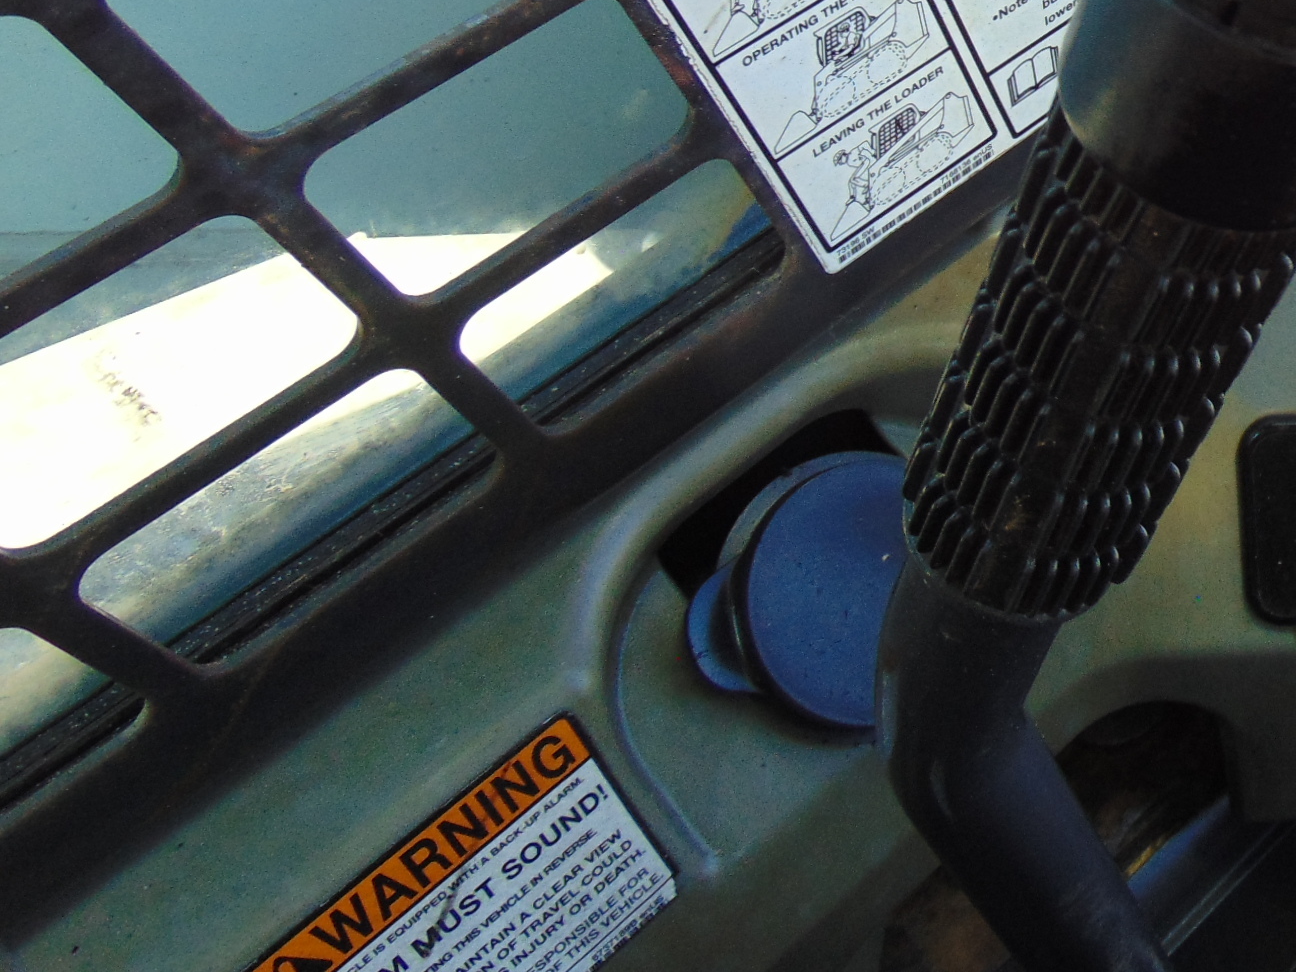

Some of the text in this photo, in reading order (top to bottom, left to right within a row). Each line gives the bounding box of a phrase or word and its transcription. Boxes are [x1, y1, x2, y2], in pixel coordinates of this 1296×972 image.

[742, 14, 819, 67] OPERATING
[812, 66, 944, 157] LEAVING THE LOADER
[308, 735, 575, 955] WARNING
[372, 943, 386, 956] IS
[386, 891, 447, 944] EQUIPPED
[448, 864, 479, 891] WITH
[479, 856, 490, 867] A
[490, 811, 541, 857] BACK-UP
[543, 777, 584, 813] ALARM.
[410, 784, 609, 959] MUST SOUND!
[520, 911, 532, 924] A
[532, 864, 584, 910] CLEAR
[584, 829, 622, 864] VIEW
[618, 867, 650, 897] FOR
[451, 928, 481, 953] THIS
[480, 884, 532, 928] VEHICLE
[530, 872, 544, 887] IN
[497, 839, 632, 960] OF TRAVEL COULD
[510, 849, 646, 967] INJURY OR DEATH.
[565, 928, 600, 959] THIS
[600, 873, 664, 927] VEHICLE.
